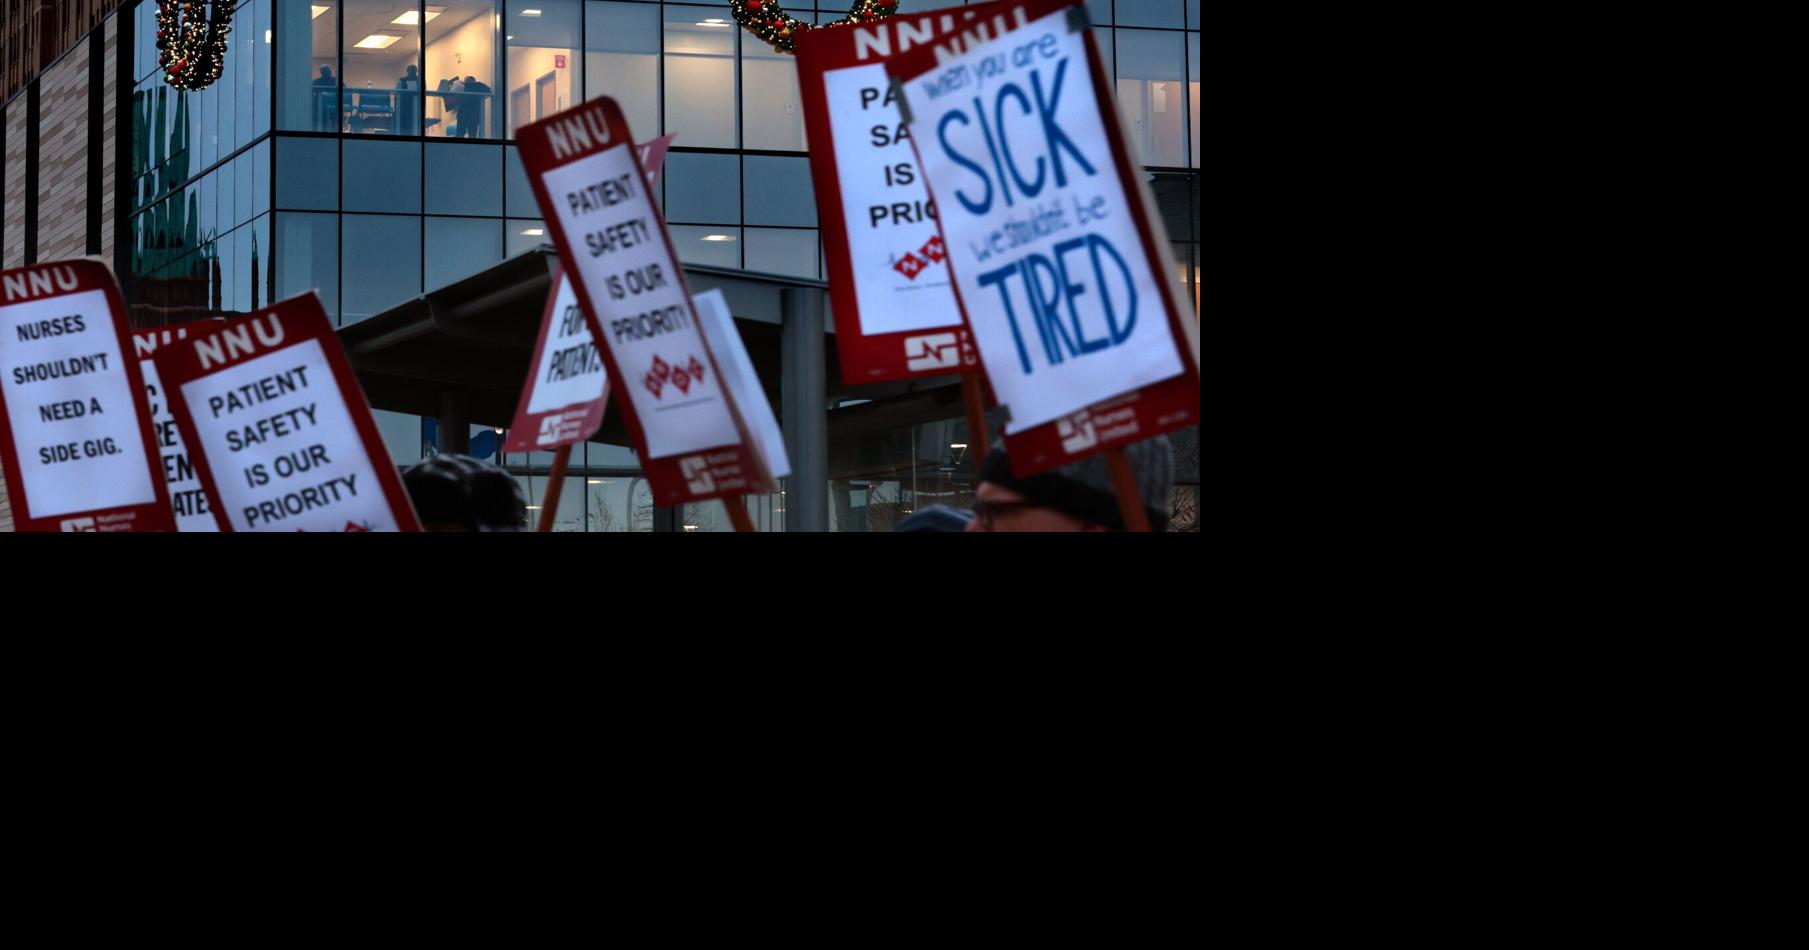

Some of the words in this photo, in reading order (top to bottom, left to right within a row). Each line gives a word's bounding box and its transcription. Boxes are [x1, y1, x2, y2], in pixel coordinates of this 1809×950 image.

[853, 11, 975, 61] NN
[545, 106, 610, 160] NNU
[936, 56, 1097, 215] SICK
[566, 172, 635, 218] PATIENT
[885, 162, 915, 187] IS
[584, 217, 650, 258] SAFETY
[3, 265, 79, 301] NNU
[605, 273, 625, 301] IS
[627, 263, 668, 297] OUR
[977, 232, 1138, 375] TIRED
[16, 314, 86, 342] NURSES
[194, 312, 285, 371] NNU
[611, 304, 691, 345] PRIORITY
[13, 353, 109, 385] SHOULDN'T
[208, 365, 309, 419] PATIENT
[39, 399, 85, 423] NEED
[86, 398, 103, 416] A
[225, 403, 318, 453] SAFETY
[39, 442, 81, 465] SIDE
[83, 438, 122, 460] GIG.
[244, 463, 271, 489] IS
[274, 443, 331, 478] OUR
[243, 474, 358, 529] PRIORITY
